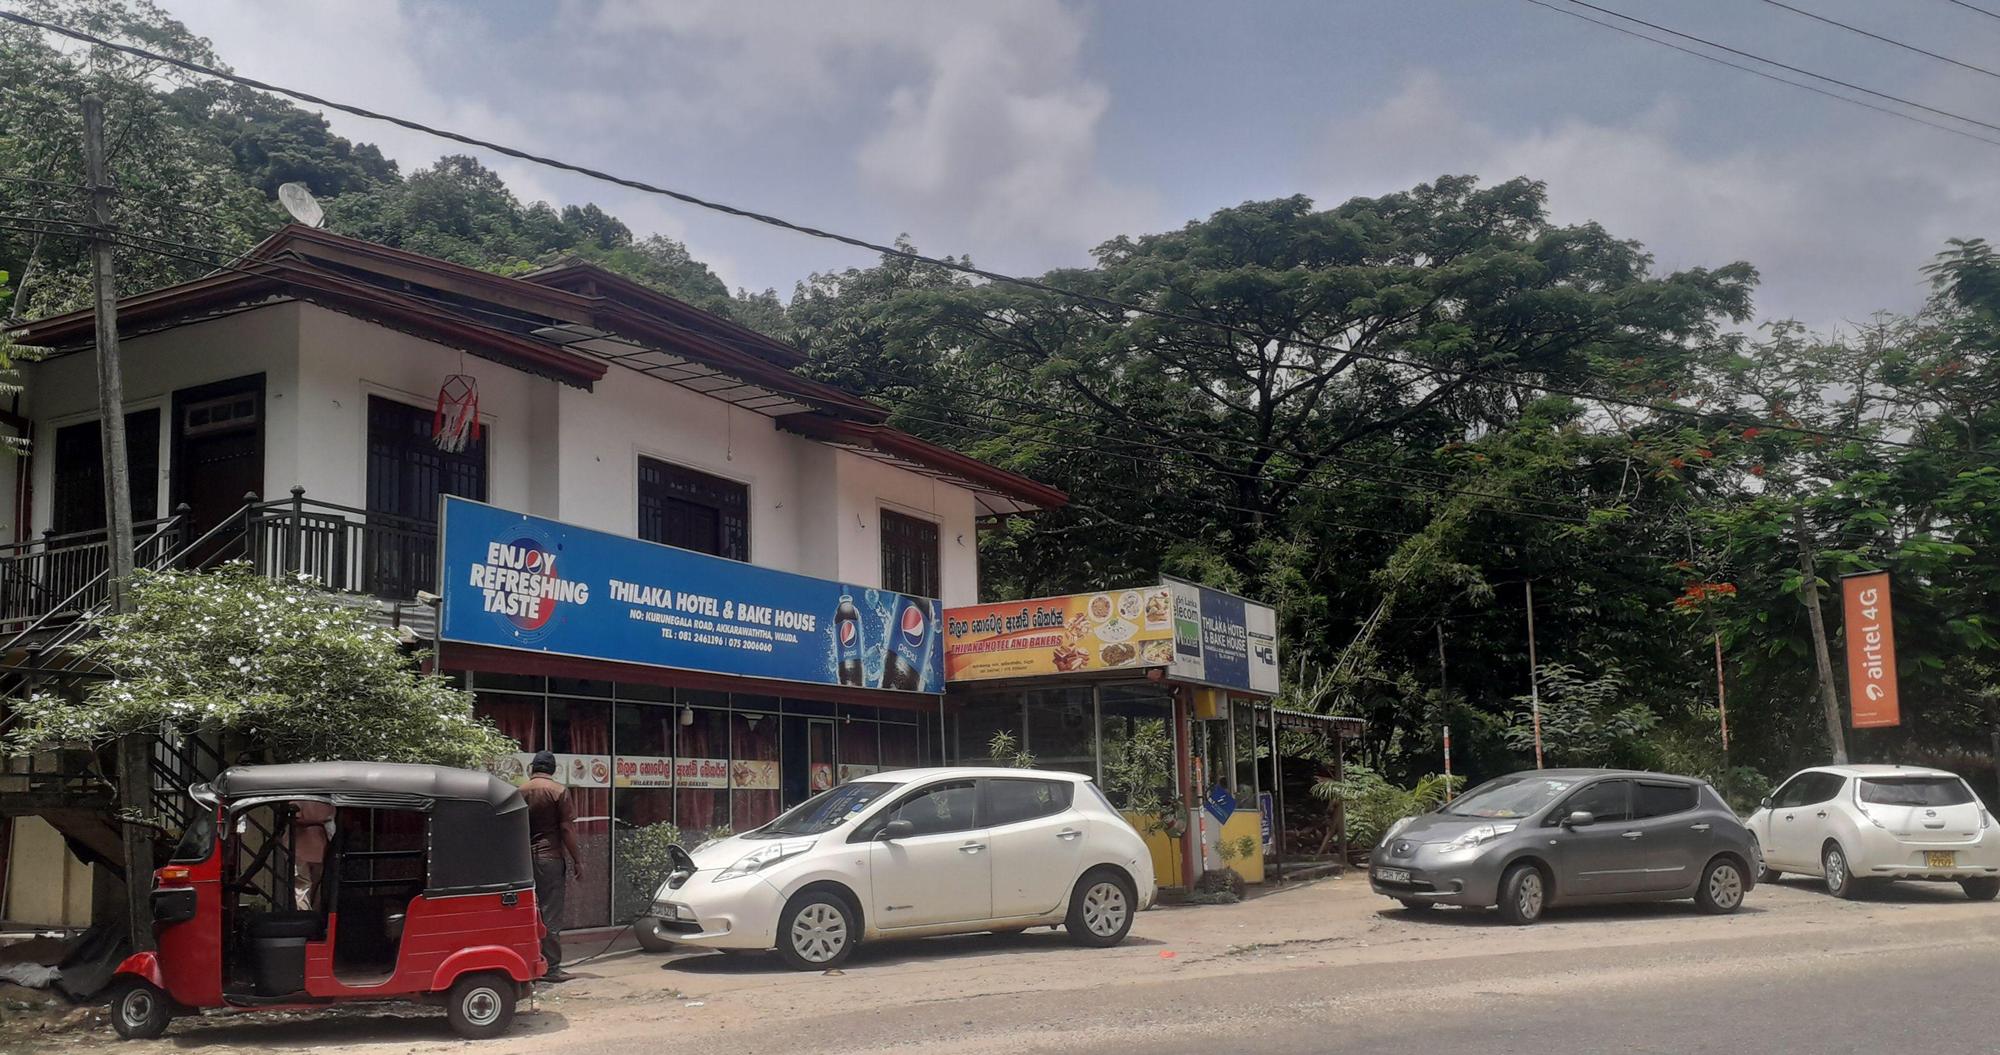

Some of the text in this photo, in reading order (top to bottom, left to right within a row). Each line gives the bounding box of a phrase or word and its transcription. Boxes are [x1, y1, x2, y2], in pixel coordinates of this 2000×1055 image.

[470, 563, 589, 605] REFRESHING
[483, 589, 541, 619] TASTE
[609, 579, 816, 632] THILAKA HOTEL & BAKE HOUSE
[629, 609, 644, 620] NO:
[645, 611, 692, 628] KURUNEGALA
[693, 619, 715, 632] ROAD,
[1202, 617, 1227, 634] THILAKA
[1227, 623, 1246, 639] HOTEL
[661, 628, 673, 638] TEL
[678, 631, 692, 641] 081
[693, 633, 723, 646] 2461196
[728, 638, 741, 648] 075
[742, 640, 772, 652] 2006060
[984, 639, 1009, 652] HOTEL
[1011, 637, 1028, 649] AND
[1029, 635, 1064, 647] BAKERS
[1210, 632, 1226, 647] BAKE
[1227, 637, 1246, 652] HOUSE
[1860, 588, 1883, 680] airtel 4G
[898, 643, 918, 663] pepsi
